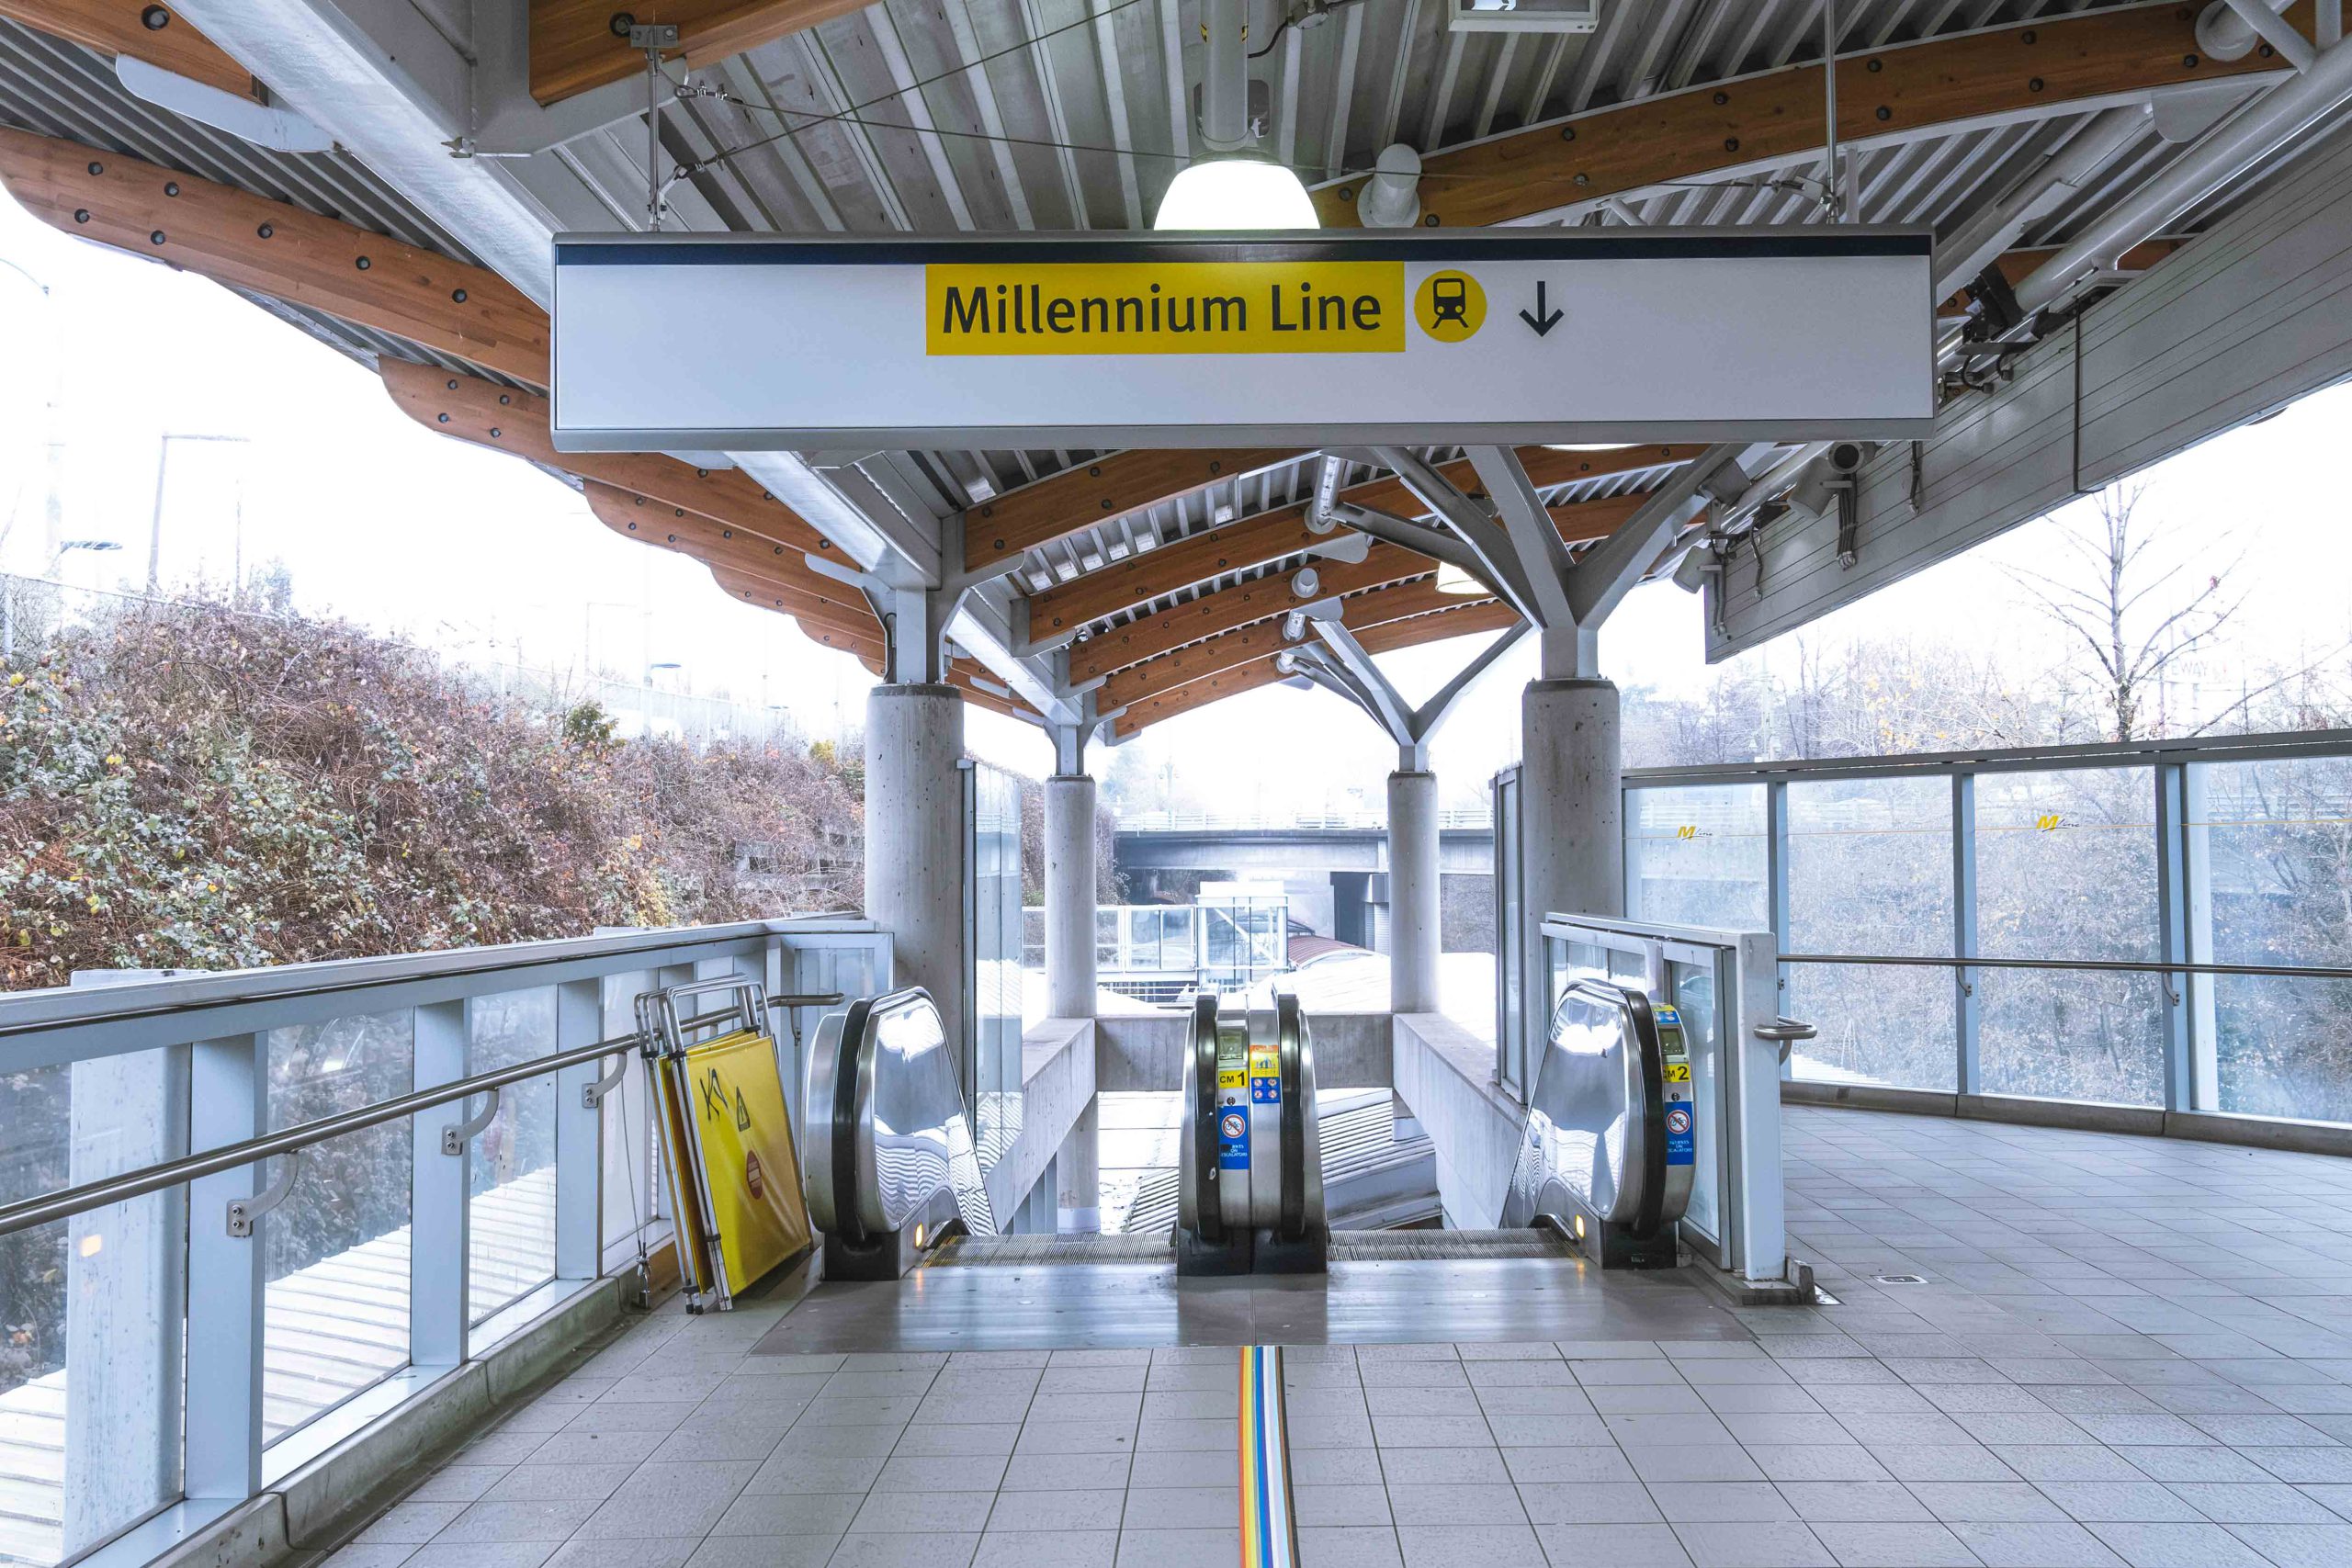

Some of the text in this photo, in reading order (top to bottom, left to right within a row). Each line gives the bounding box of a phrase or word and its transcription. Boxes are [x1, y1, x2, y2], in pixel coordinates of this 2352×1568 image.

[943, 282, 1381, 334] Millennium Line
[1219, 1075, 1235, 1084] CM
[1238, 1071, 1245, 1086] 1
[1677, 1066, 1690, 1080] 2
